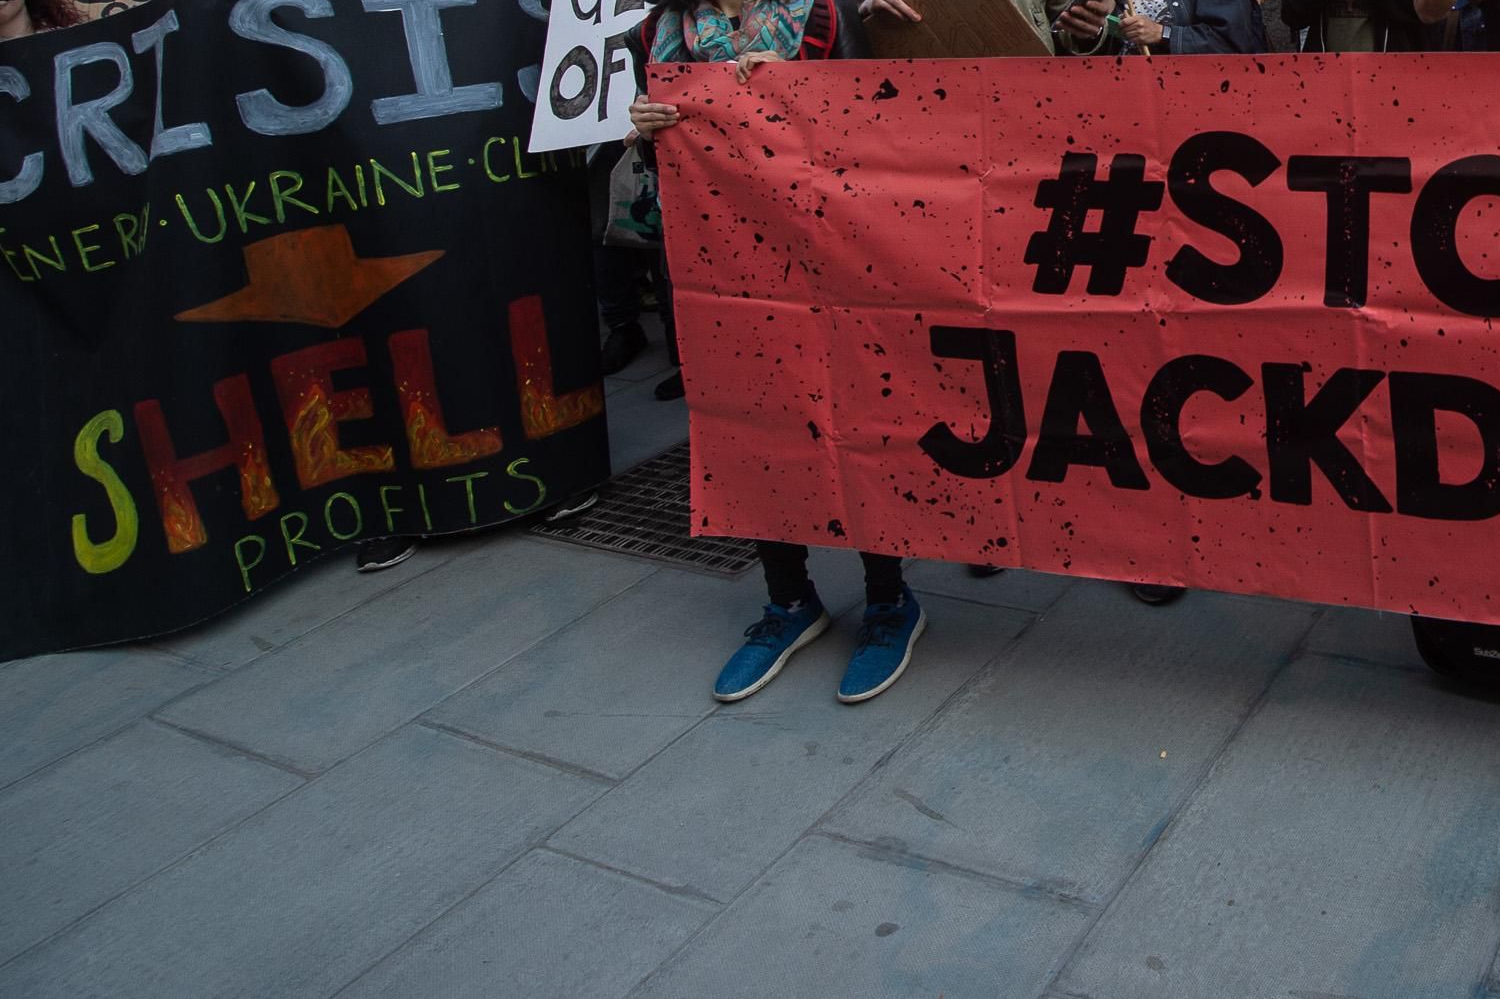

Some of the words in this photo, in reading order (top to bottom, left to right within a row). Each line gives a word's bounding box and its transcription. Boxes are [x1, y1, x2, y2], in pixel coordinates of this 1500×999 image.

[176, 149, 460, 244] UKRAINE
[72, 295, 603, 574] SHELL
[233, 457, 547, 592] PROFITS
